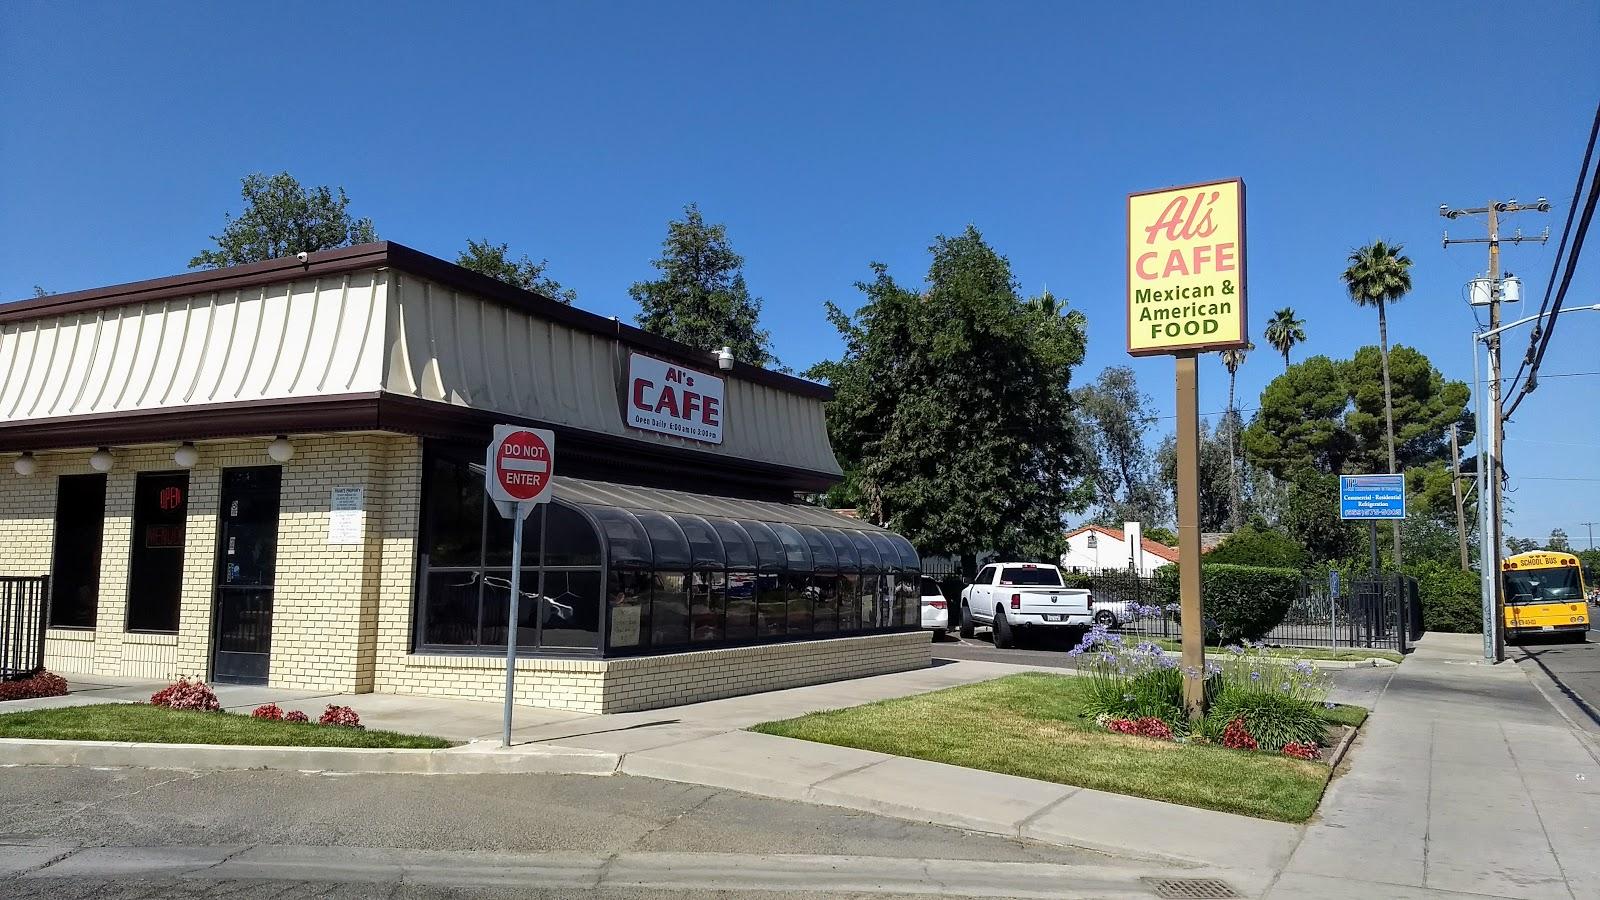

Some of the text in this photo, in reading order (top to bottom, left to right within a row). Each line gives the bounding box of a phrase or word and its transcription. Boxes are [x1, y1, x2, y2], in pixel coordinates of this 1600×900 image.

[1145, 191, 1220, 244] Al's
[1135, 242, 1236, 280] CAFE
[1135, 279, 1235, 304] Mexican &
[1139, 302, 1231, 322] American
[1151, 319, 1219, 339] FOOD
[665, 367, 694, 387] Al's
[633, 377, 720, 427] CAFE
[635, 415, 650, 425] Open
[652, 419, 667, 429] Daily
[504, 443, 545, 458] DO NOT
[506, 472, 541, 486] ENTER
[160, 486, 181, 510] OPEN
[1520, 557, 1558, 567] SCHOOL BUS
